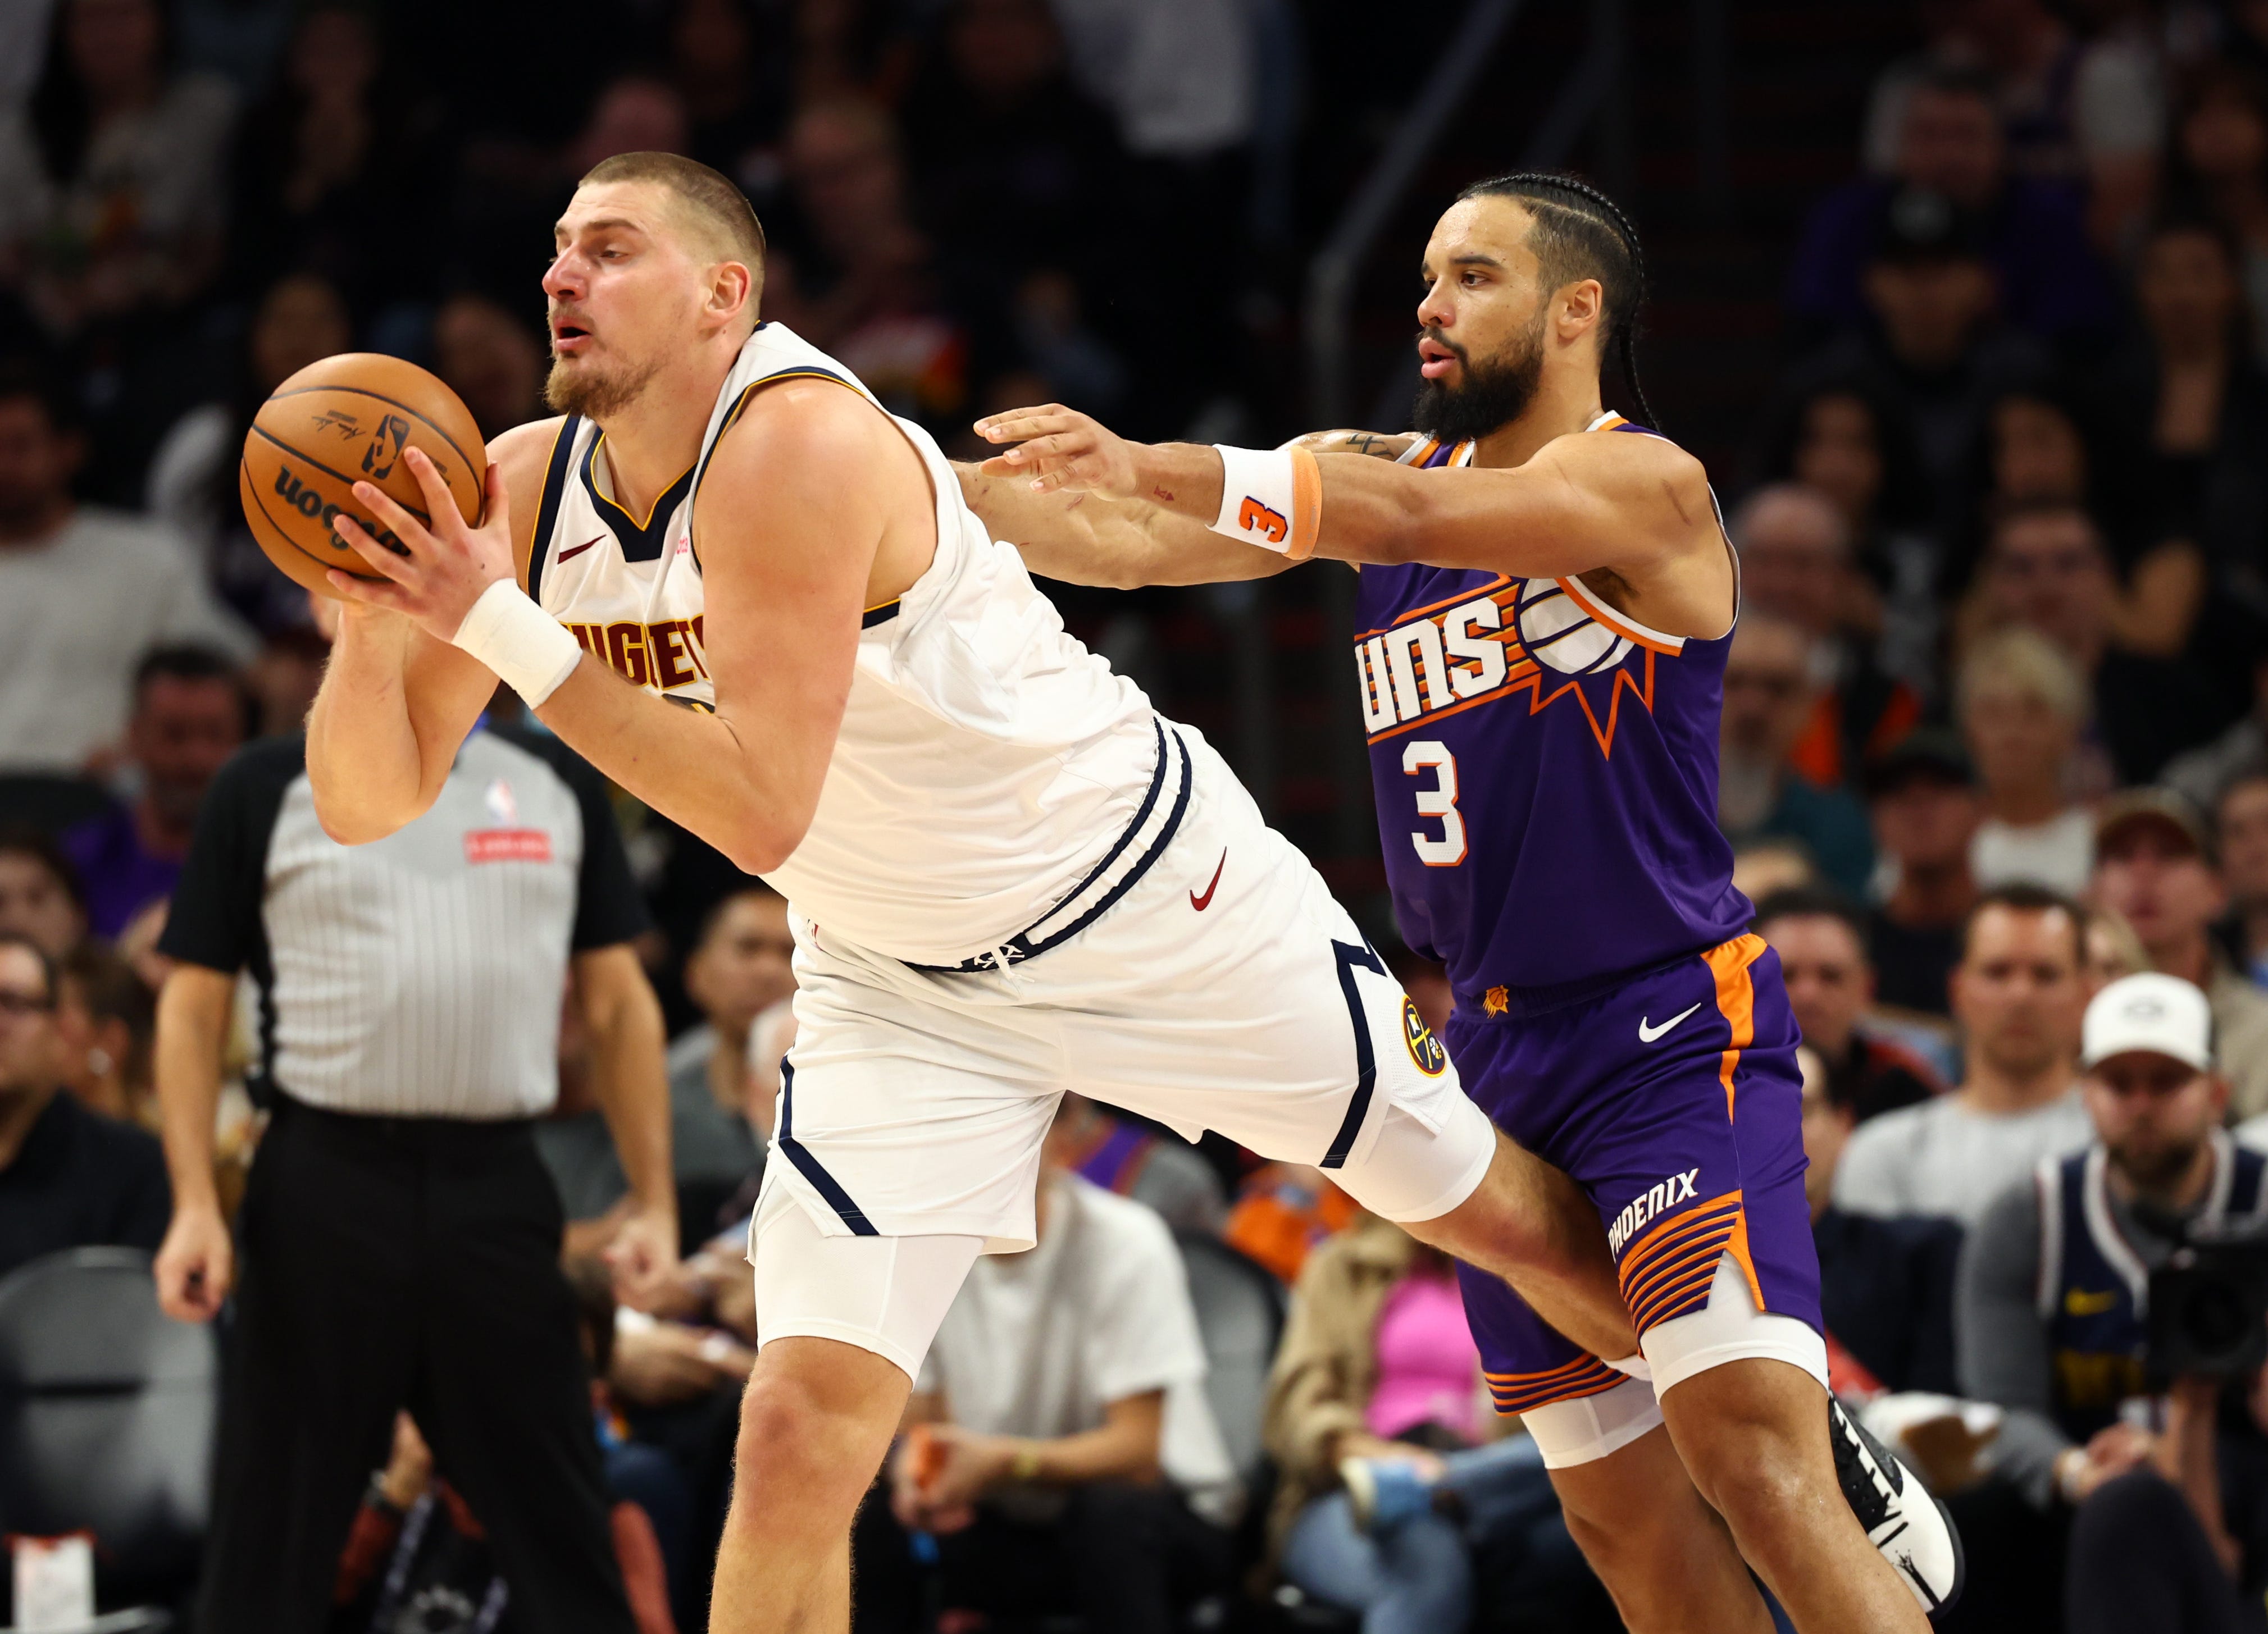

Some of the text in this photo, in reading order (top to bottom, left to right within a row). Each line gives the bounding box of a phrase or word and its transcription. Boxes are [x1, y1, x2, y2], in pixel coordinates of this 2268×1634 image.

[1238, 495, 1288, 542] 3
[1402, 741, 1468, 866] 3
[1608, 1168, 1698, 1263] PHOENIX
